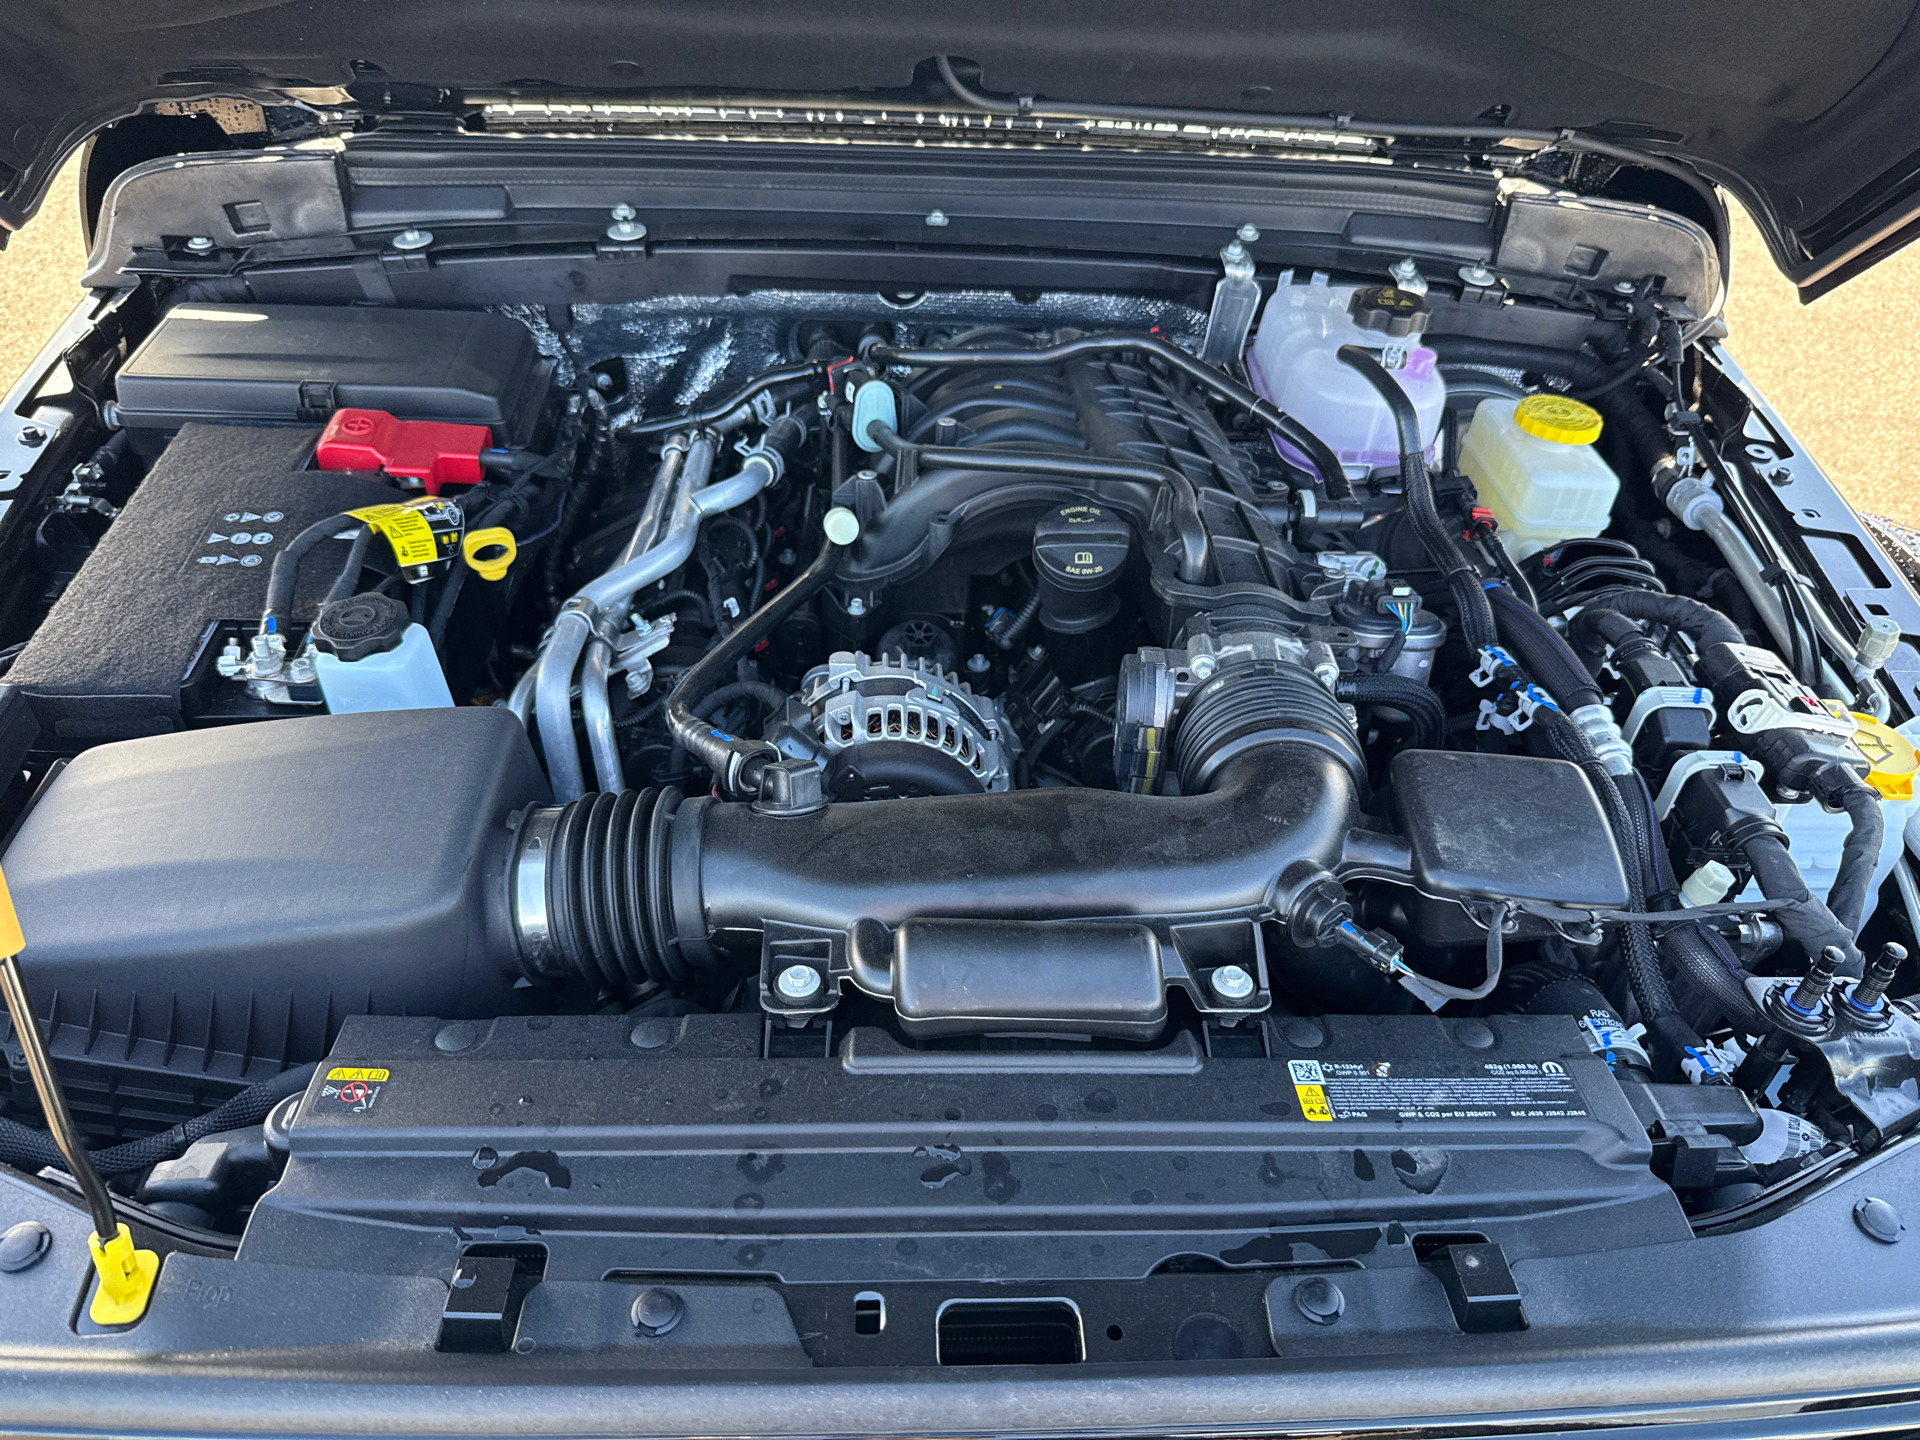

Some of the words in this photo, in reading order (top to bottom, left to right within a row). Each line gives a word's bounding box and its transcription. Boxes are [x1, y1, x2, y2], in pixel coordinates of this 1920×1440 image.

[1060, 506, 1088, 516] ENGINE
[1089, 507, 1101, 516] OIL
[1065, 565, 1080, 575] SAE
[1081, 565, 1103, 575] 0W-20
[1589, 1009, 1610, 1018] RAD
[182, 1279, 231, 1307] Prop
